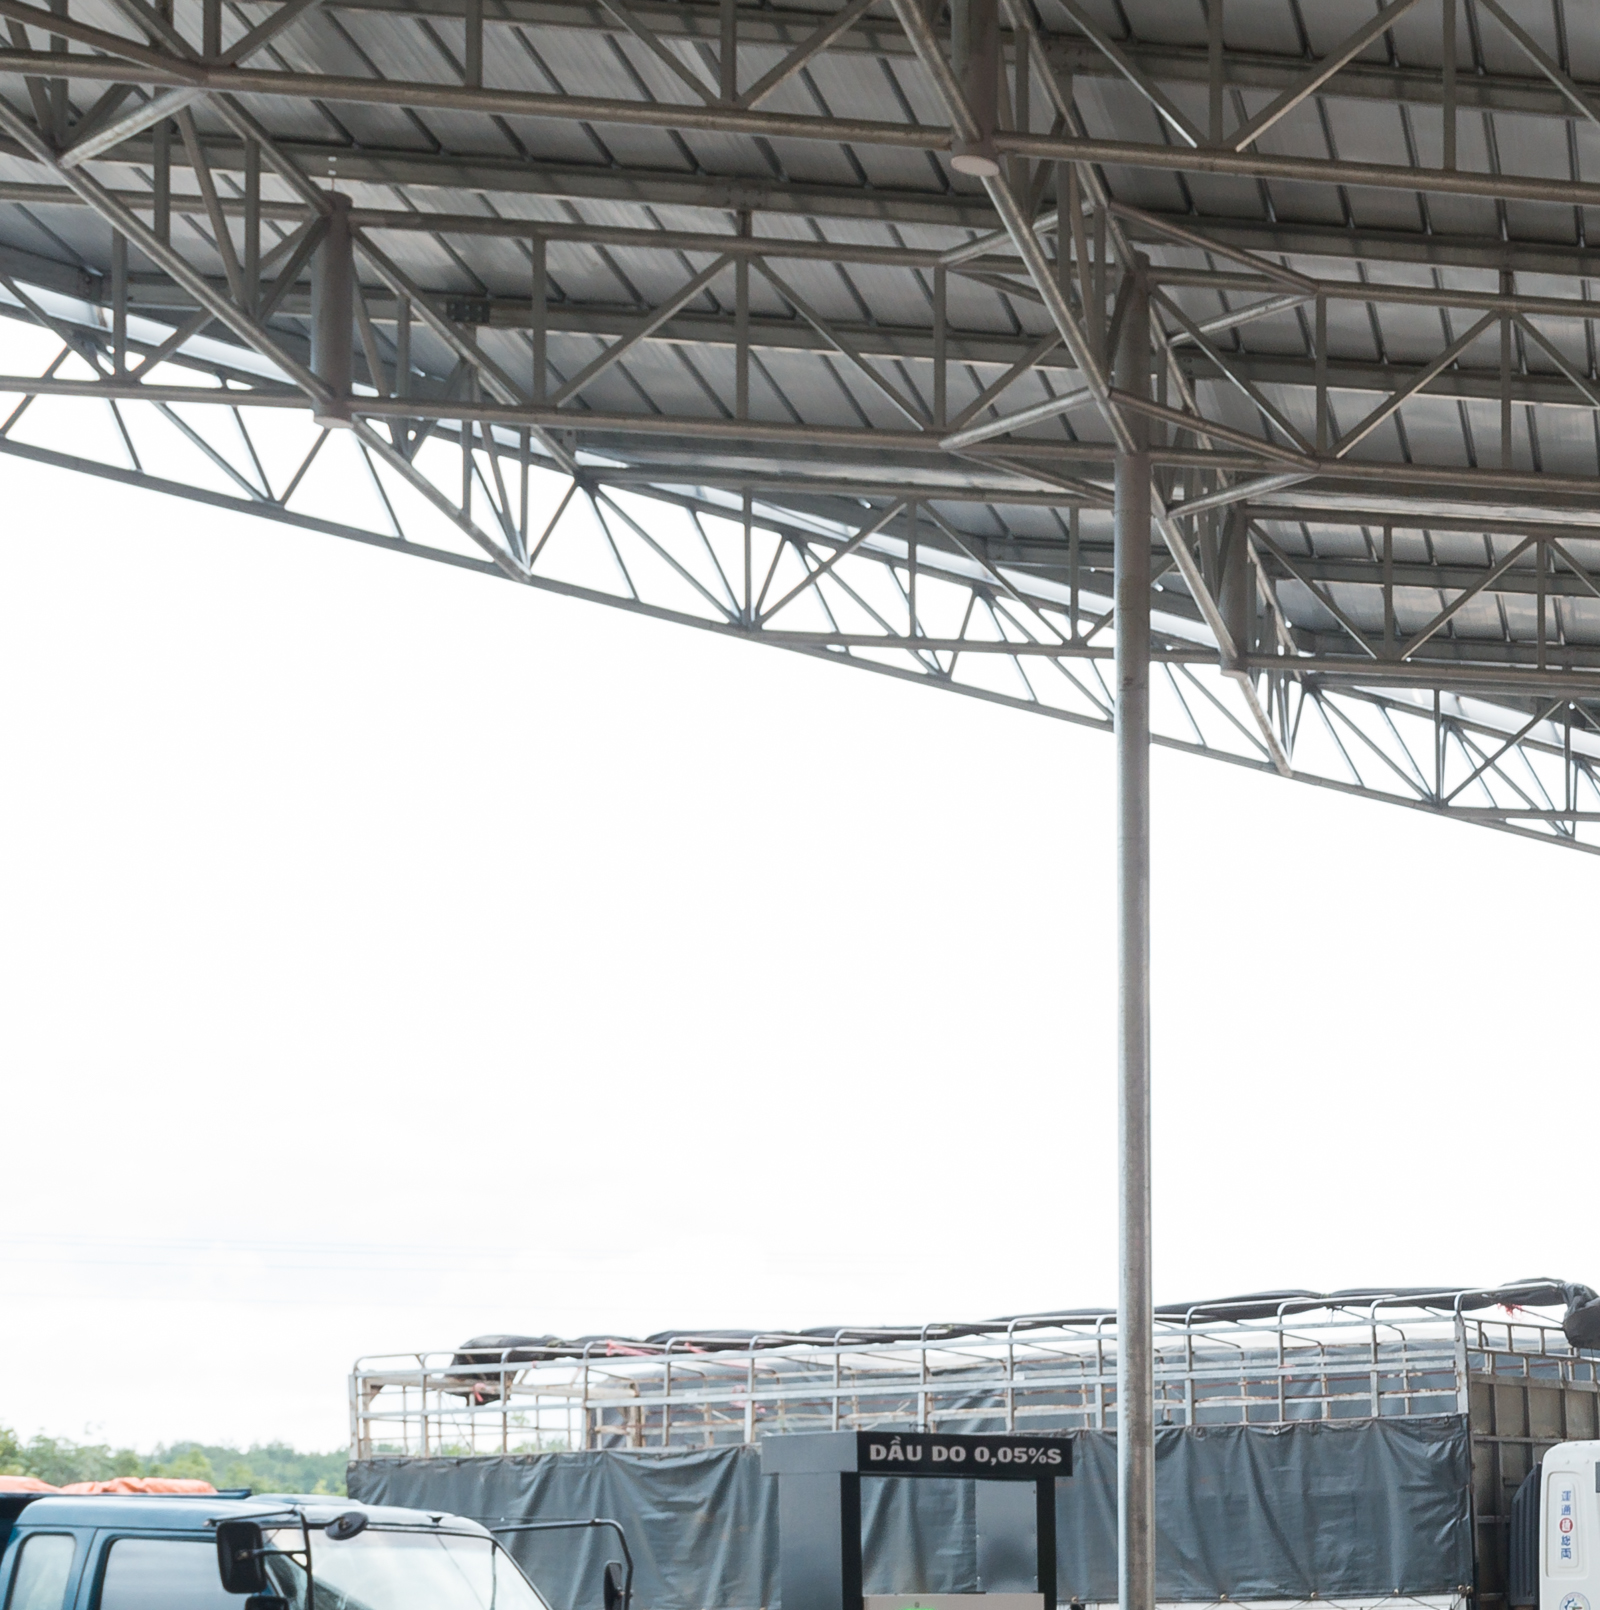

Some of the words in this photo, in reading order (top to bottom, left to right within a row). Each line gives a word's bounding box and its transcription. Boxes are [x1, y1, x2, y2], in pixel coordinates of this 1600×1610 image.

[869, 1436, 923, 1461] DẦU
[931, 1446, 967, 1462] DO
[974, 1446, 1062, 1466] 0,05%S
